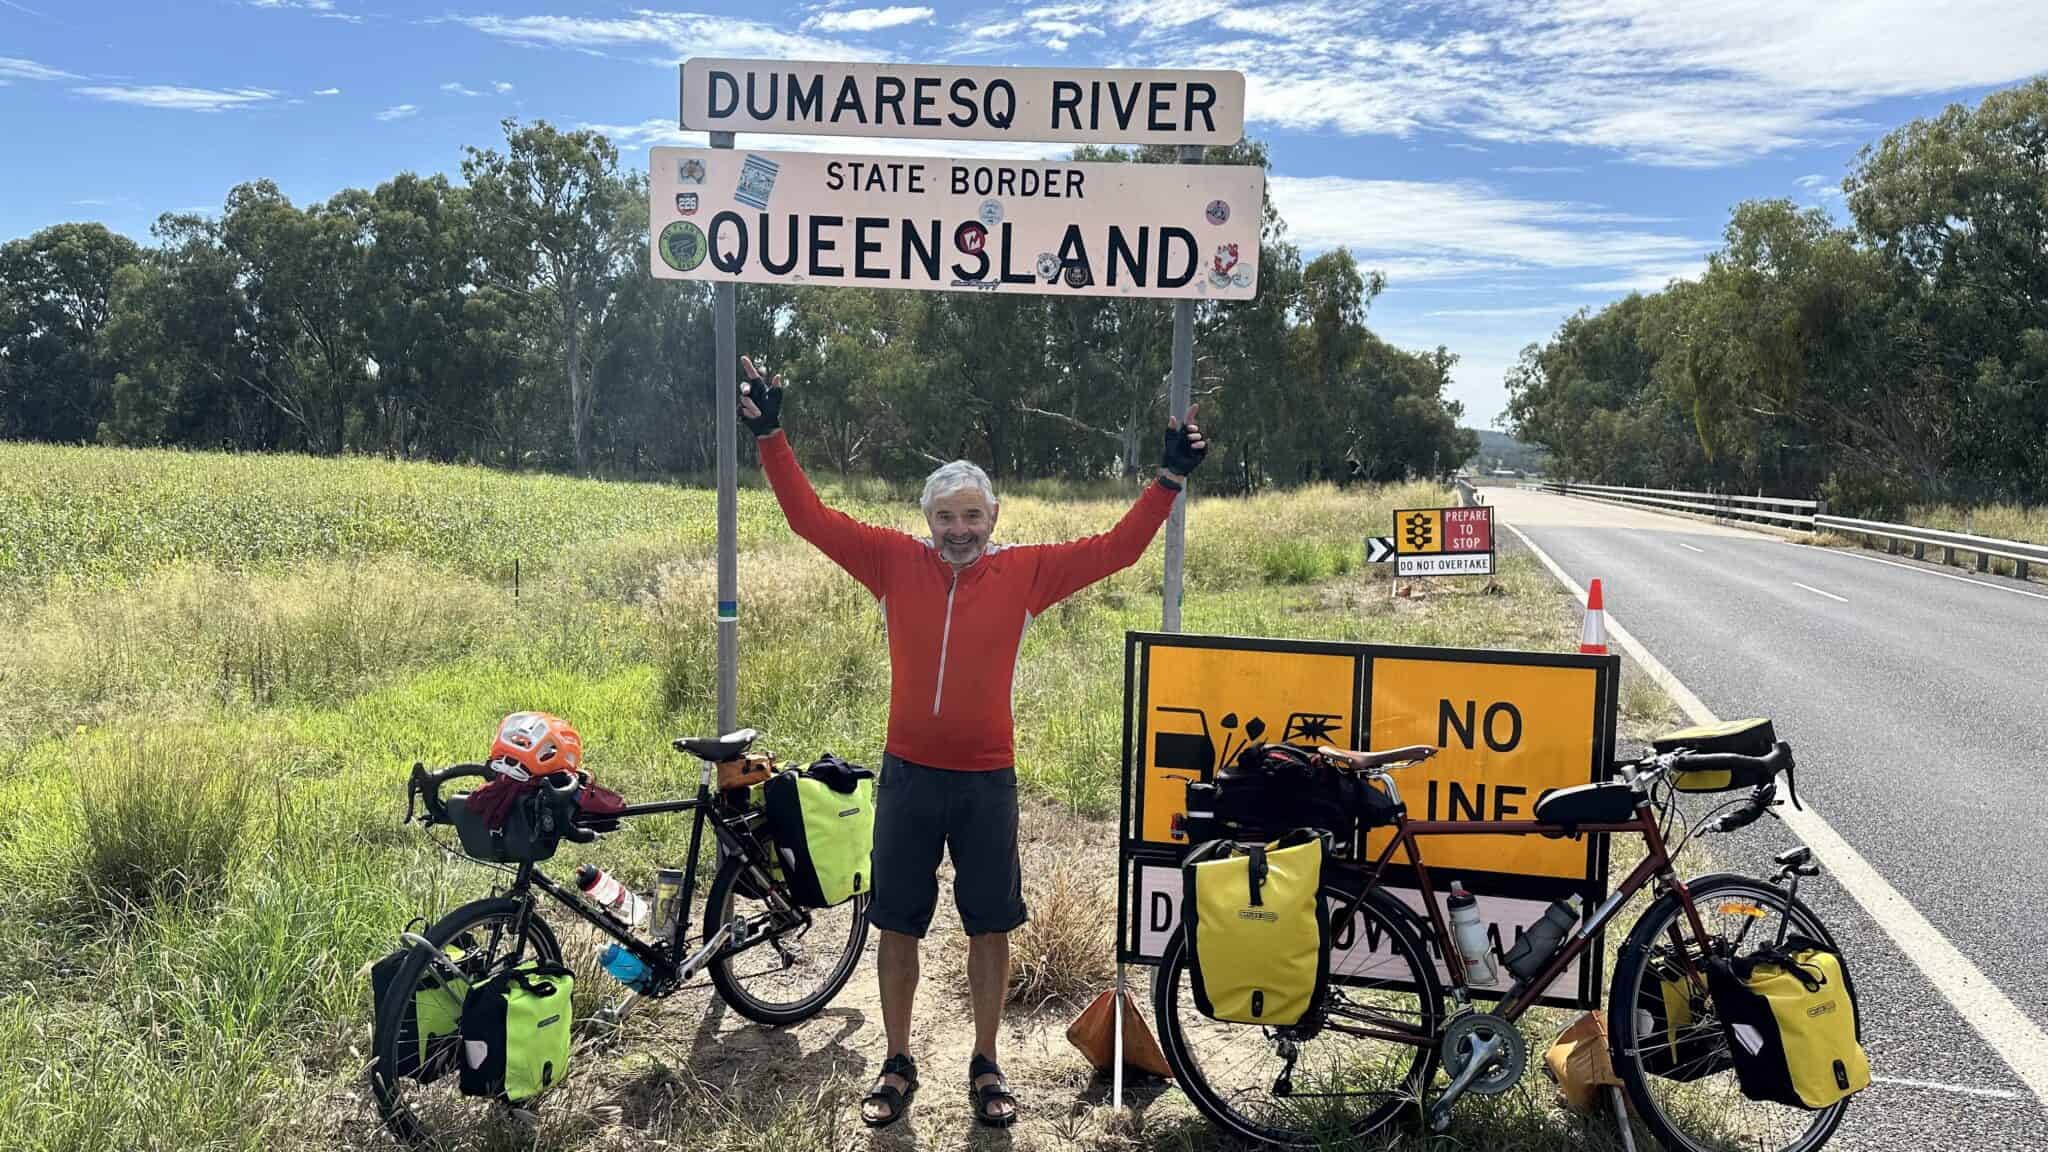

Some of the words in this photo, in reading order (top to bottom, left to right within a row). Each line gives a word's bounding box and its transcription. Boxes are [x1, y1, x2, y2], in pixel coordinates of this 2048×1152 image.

[708, 70, 1016, 131] DUMARESQ
[1051, 80, 1217, 132] RIVER
[826, 161, 925, 194] STATE
[951, 165, 1085, 199] BORDER
[708, 210, 1199, 289] QUEENSLAND
[1445, 510, 1488, 522] PREPARE
[1460, 524, 1473, 536] TO
[1453, 537, 1481, 549] STOP
[1400, 561, 1413, 571] DO
[1416, 560, 1434, 571] NOT
[1438, 559, 1489, 570] OVERTAKE
[1438, 698, 1522, 753] NO
